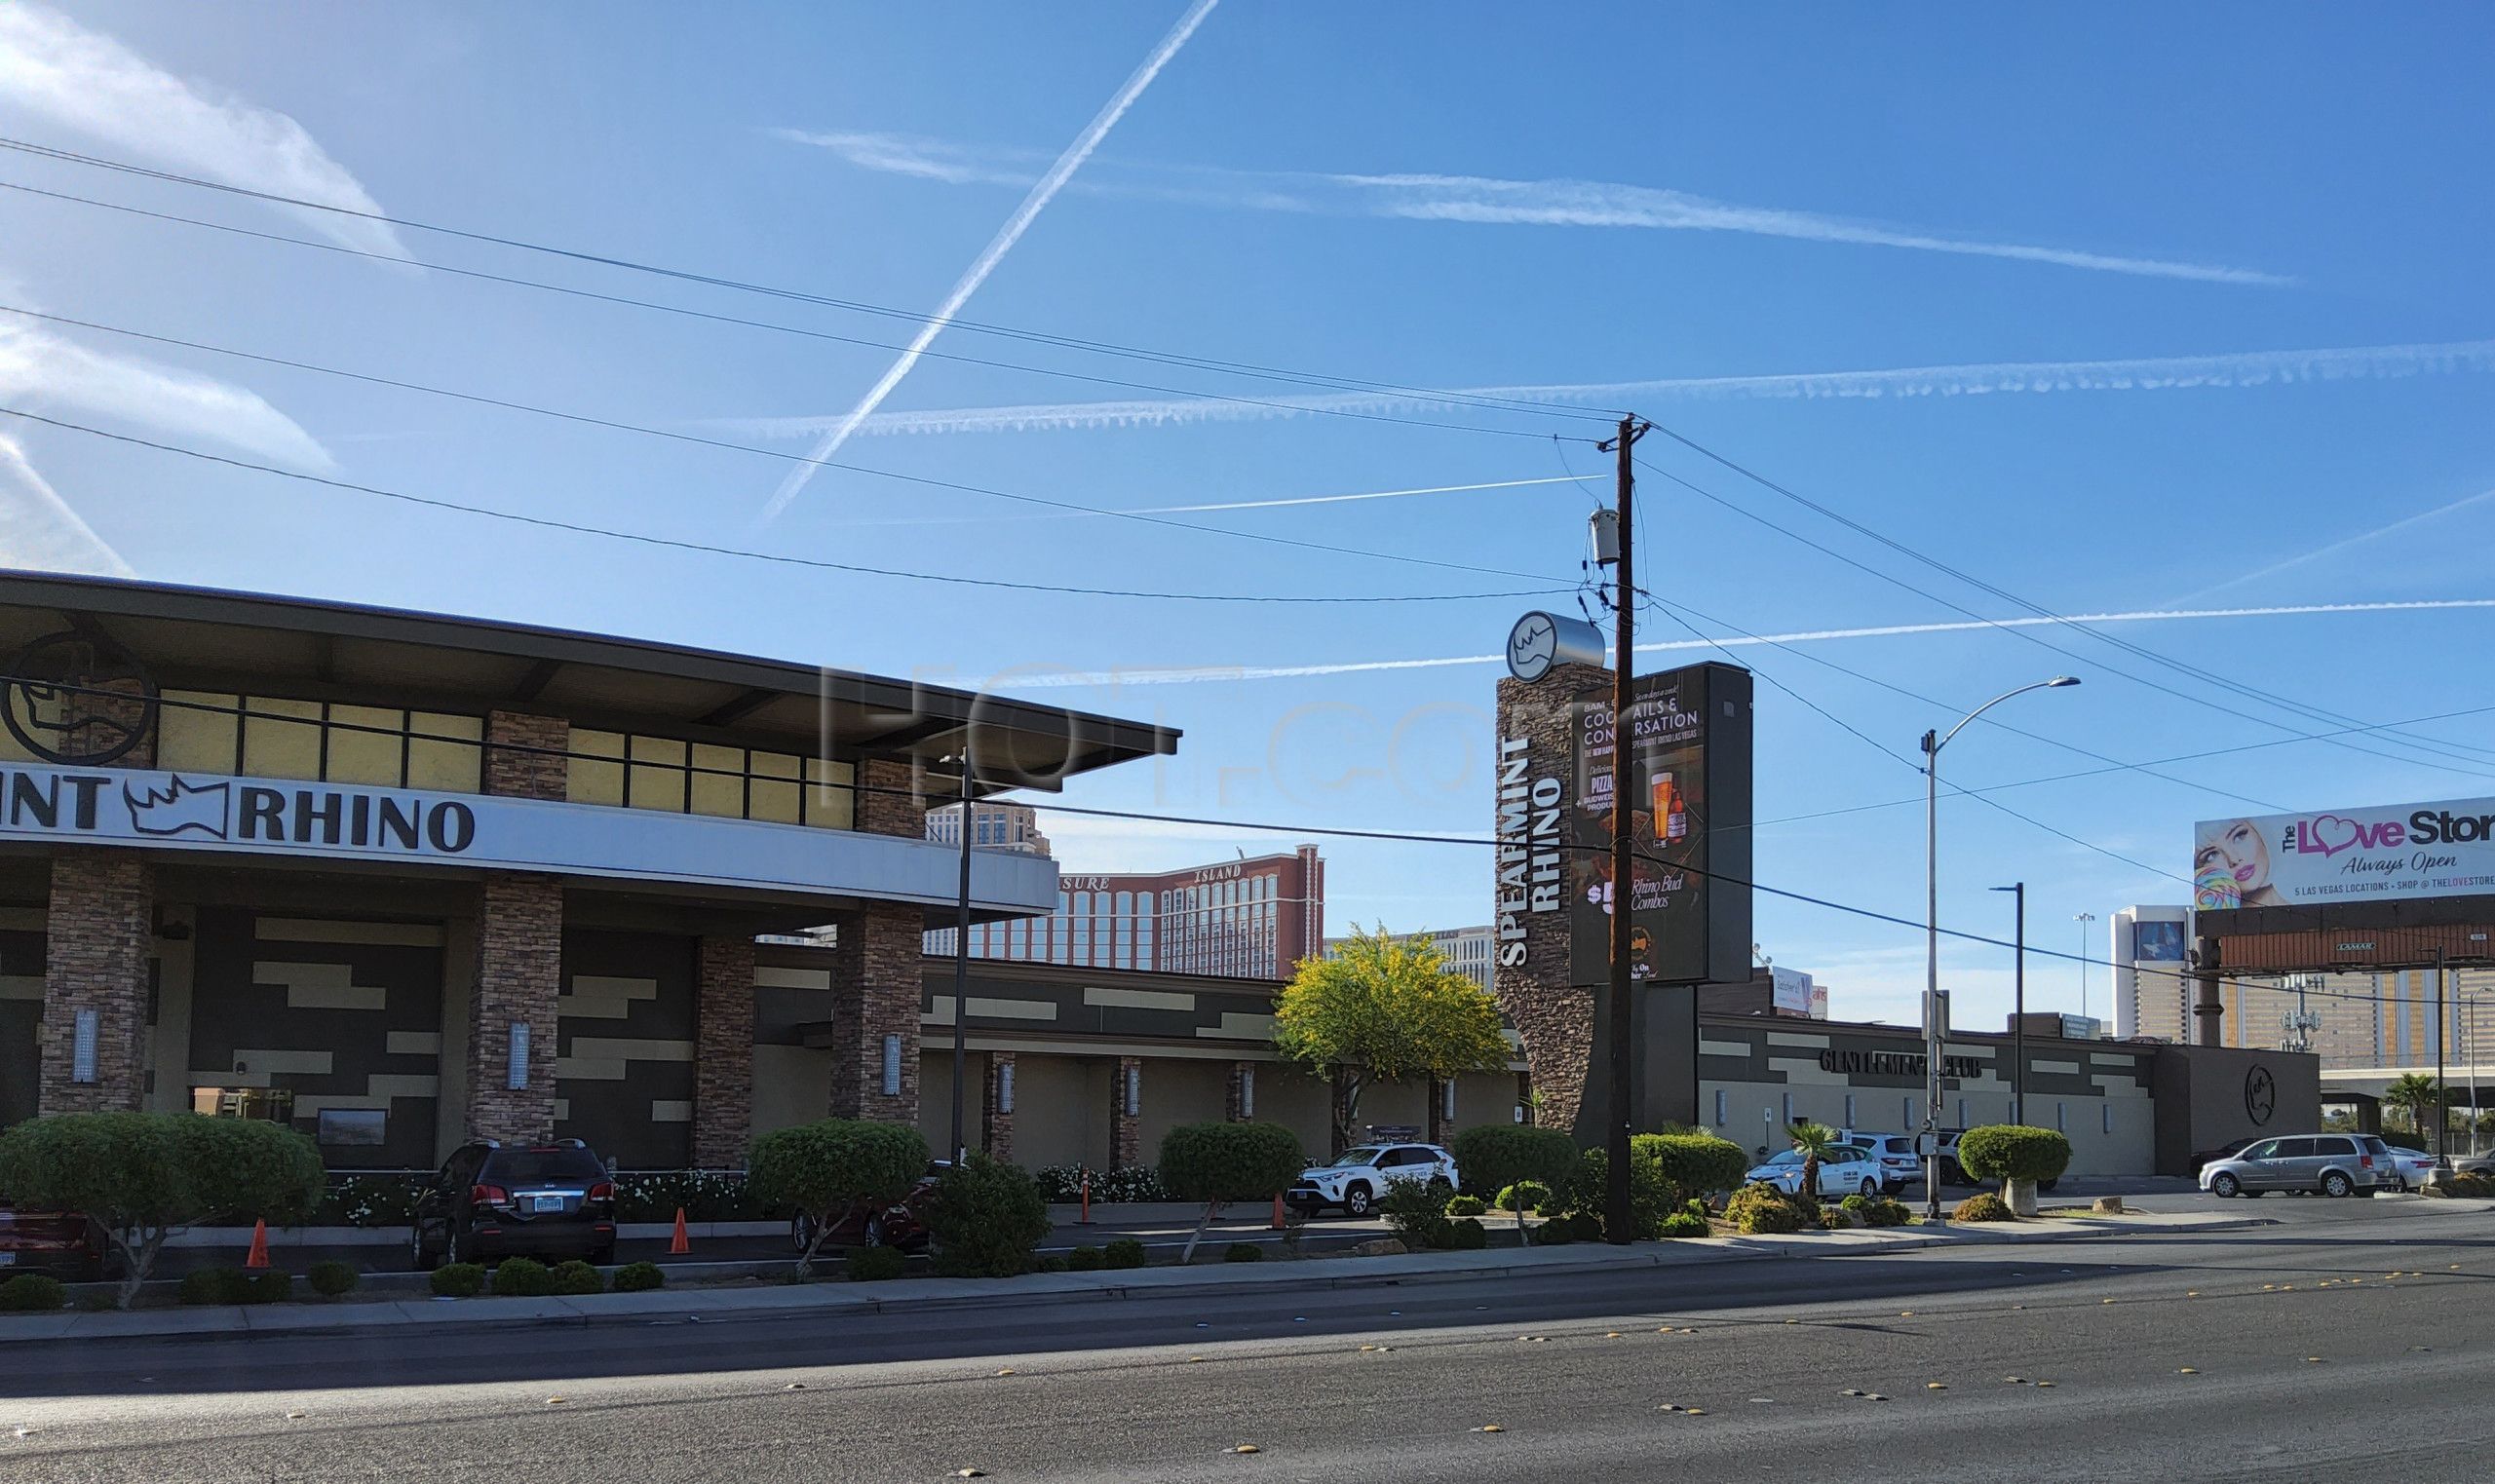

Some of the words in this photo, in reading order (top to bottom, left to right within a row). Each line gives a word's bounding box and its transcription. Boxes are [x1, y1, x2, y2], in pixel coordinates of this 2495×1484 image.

[1584, 702, 1606, 712] 8AM
[1592, 775, 1614, 794] PIZZA
[1584, 793, 1615, 805] BUDWEIS
[1588, 801, 1615, 812] PRODU
[0, 773, 111, 829] NT
[238, 786, 476, 853] RHINO
[1532, 778, 1561, 913] RHINO
[2282, 825, 2296, 854] The
[1501, 736, 1529, 967] SPEARMINT
[2340, 856, 2406, 875] Always
[2410, 852, 2457, 874] Open
[1059, 877, 1109, 892] SURE
[1194, 865, 1242, 883] ISLAND
[1631, 877, 1661, 895] Rhino
[1662, 874, 1683, 893] Bud
[2302, 886, 2317, 895] LAS
[2319, 884, 2343, 894] VEGAS
[2346, 882, 2389, 893] LOCATIONS
[2397, 880, 2418, 891] SHOP
[1631, 893, 1670, 911] Combos
[1941, 1055, 1982, 1079] CLUB
